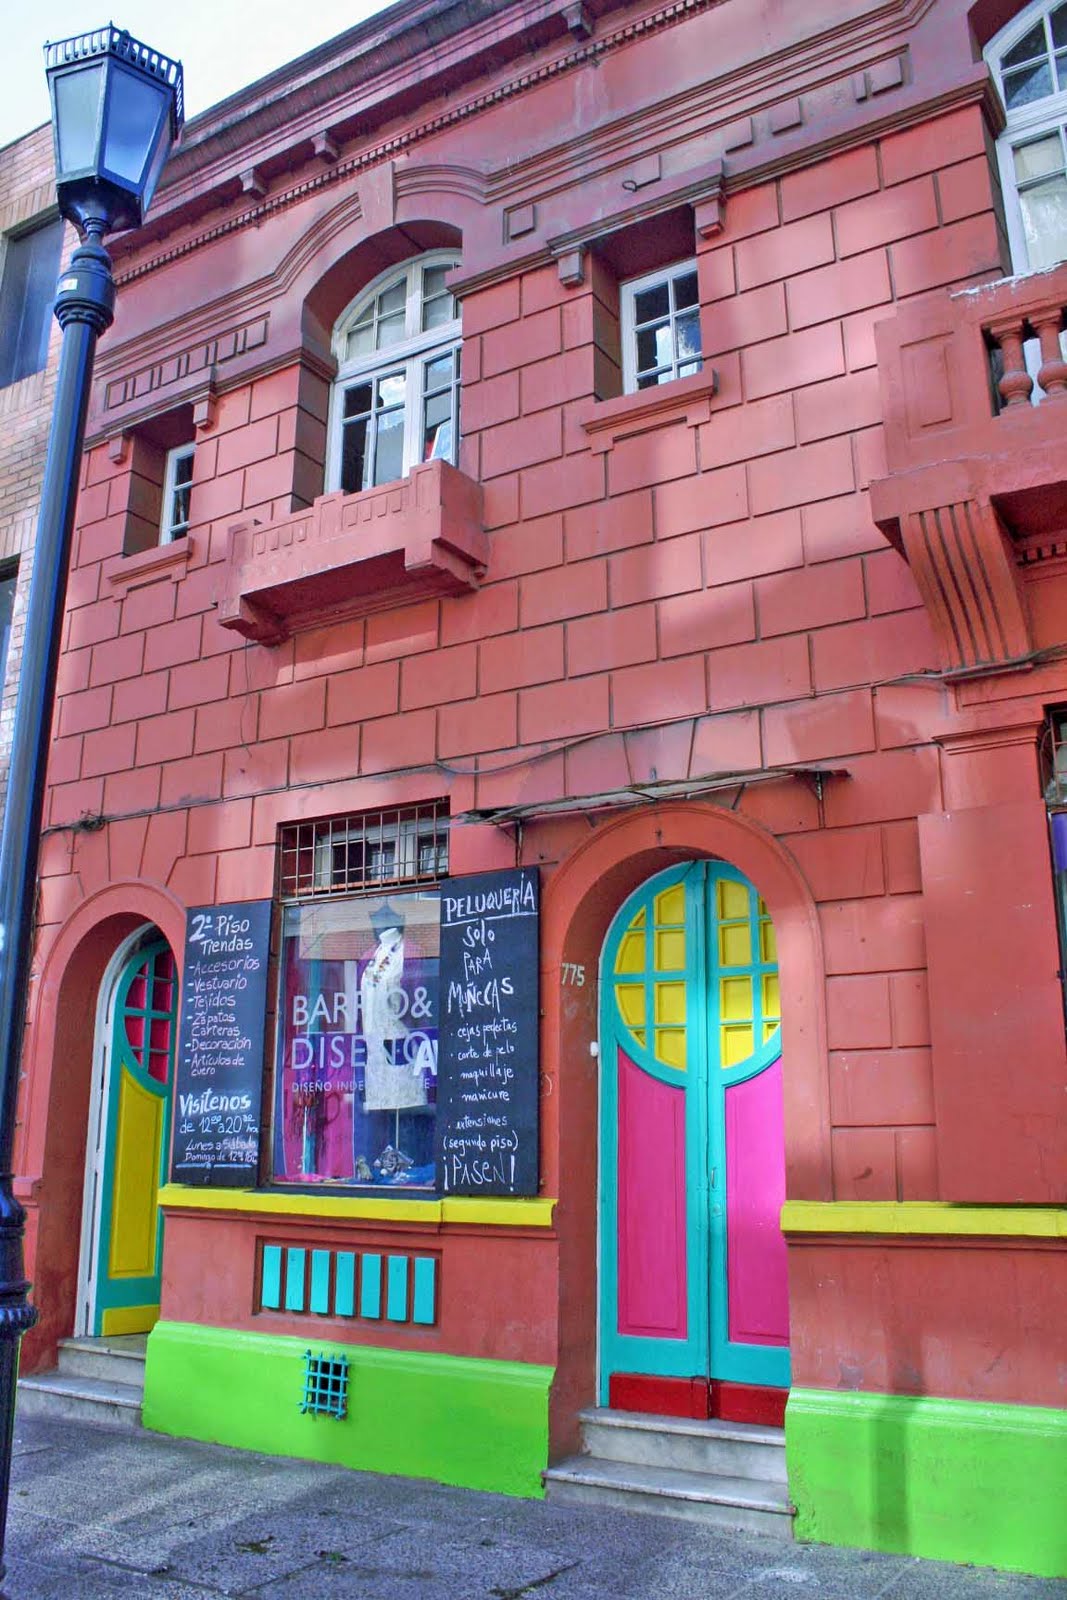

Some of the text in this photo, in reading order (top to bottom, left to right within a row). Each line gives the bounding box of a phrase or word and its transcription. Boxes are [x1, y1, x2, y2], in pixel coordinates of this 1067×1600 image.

[215, 914, 250, 936] Piso
[200, 934, 253, 955] Tiendas
[463, 948, 493, 981] PARA
[561, 962, 585, 987] 775
[191, 1025, 240, 1037] Carteras
[232, 1053, 245, 1066] de
[191, 1066, 216, 1077] cuero
[460, 1063, 514, 1087] maquillaje
[292, 1080, 333, 1093] DISEÑO
[461, 1088, 510, 1102] manicure
[179, 1119, 196, 1134] de
[217, 1122, 225, 1133] a
[455, 1113, 508, 1130] extensiones
[185, 1139, 214, 1151] Lunes
[215, 1141, 222, 1150] a
[490, 1130, 519, 1152] piso)
[184, 1151, 215, 1164] Domingo
